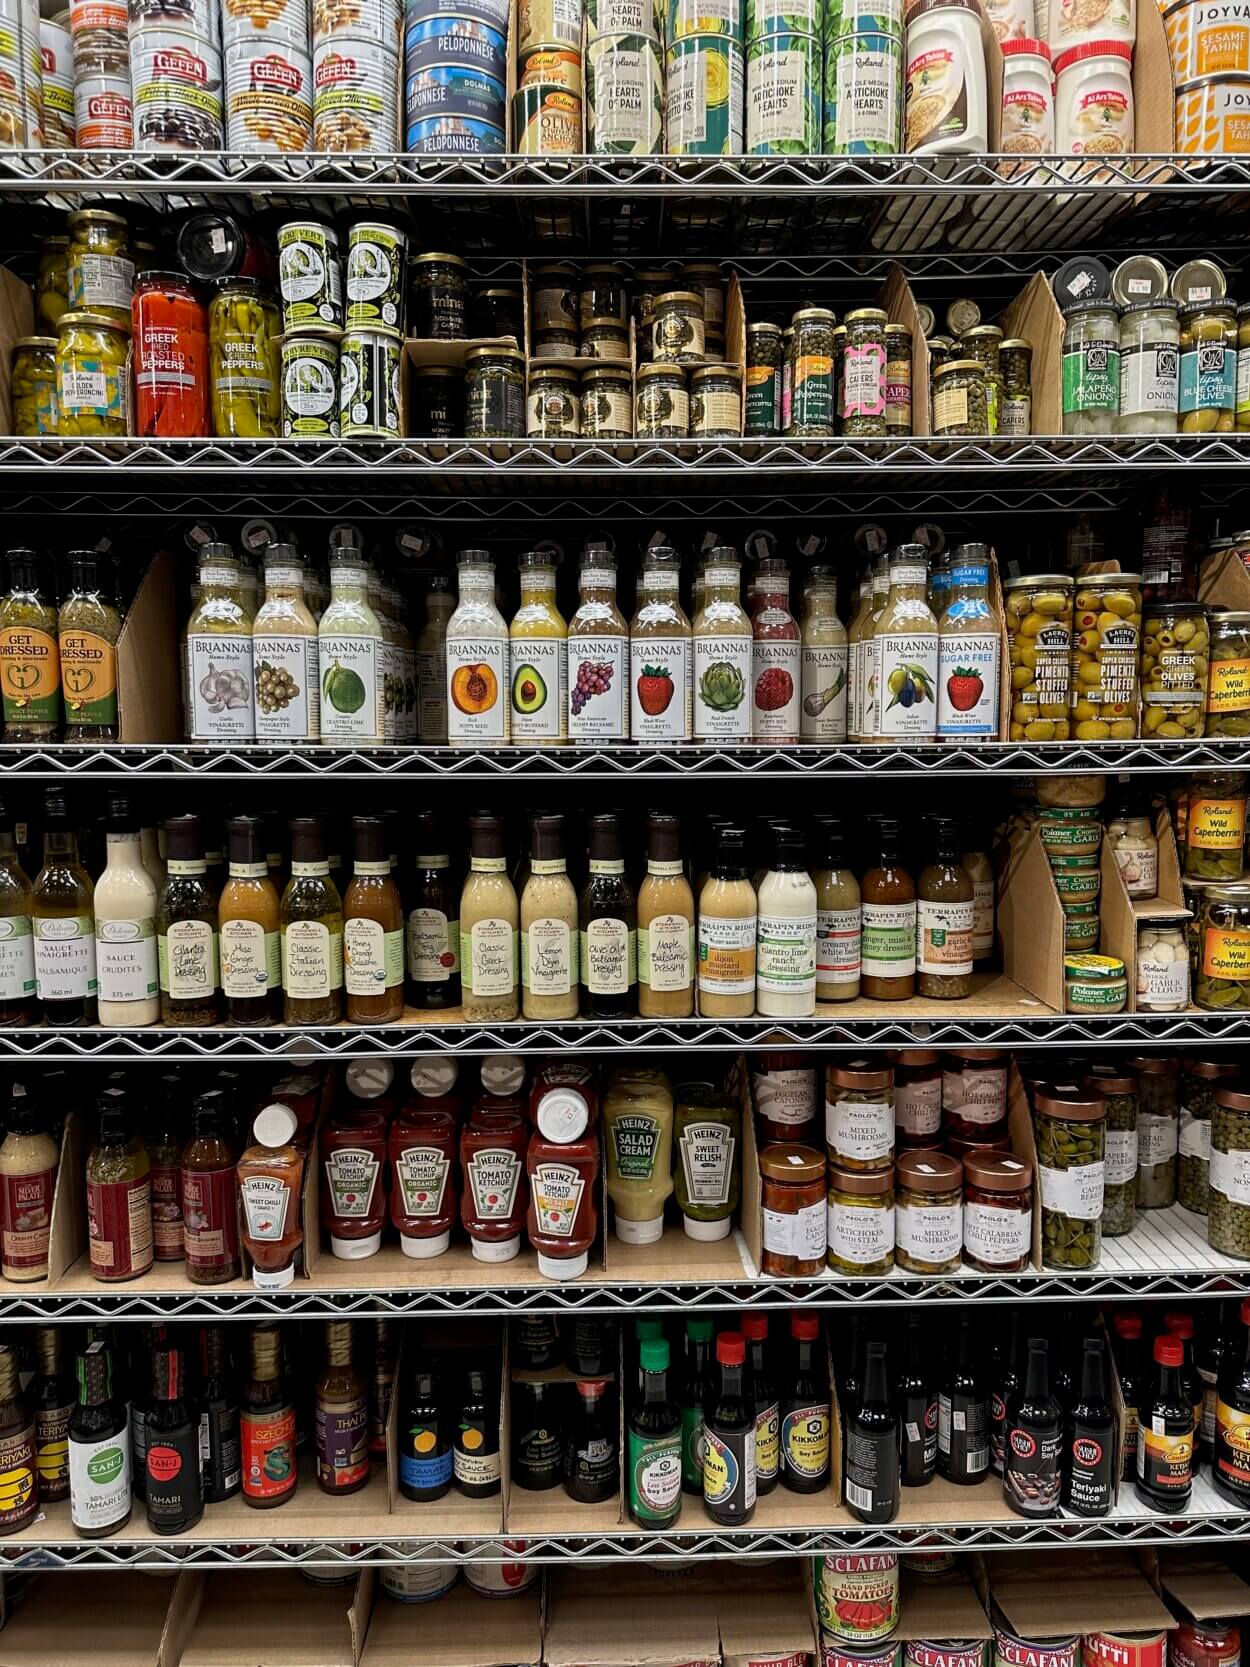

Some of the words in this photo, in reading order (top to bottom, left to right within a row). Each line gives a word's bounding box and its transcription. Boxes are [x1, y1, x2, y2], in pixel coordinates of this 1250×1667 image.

[621, 17, 642, 29] PALM
[1200, 33, 1246, 45] SESAME
[438, 37, 494, 61] PELOPONNESE
[1205, 42, 1243, 54] TAHINI
[156, 54, 203, 75] GEFEN
[855, 56, 884, 69] Roland
[464, 80, 491, 92] DOLMAS
[90, 101, 132, 116] GEFEN
[621, 99, 641, 110] PALM
[854, 100, 884, 110] HEARTS
[424, 137, 479, 152] PELOPONNESE
[145, 334, 178, 344] GREEK
[225, 344, 258, 353] GREEK
[141, 360, 184, 370] PEPPERS
[222, 360, 264, 370] PEPPERS
[807, 382, 827, 390] Green
[1205, 386, 1232, 394] CHEESE
[1077, 392, 1113, 401] ONIONS
[1197, 392, 1225, 400] OLIVES
[1002, 415, 1025, 425] CAPERS
[953, 568, 973, 577] SUGAR
[1042, 630, 1068, 638] LAUREL
[1109, 629, 1135, 638] LAUREL
[8, 635, 32, 645] GET
[65, 638, 86, 648] GET
[1113, 637, 1131, 645] HILL
[0, 646, 49, 656] DRESSED
[195, 641, 251, 654] BRIANNAS
[319, 641, 371, 653] BRIANNAS
[449, 645, 500, 656] BRIANNAS
[568, 642, 619, 654] BRIANNAS
[632, 645, 682, 656] BRIANNAS
[697, 642, 749, 654] BRIANNAS
[886, 641, 937, 652] BRIANNAS
[939, 641, 994, 652] BRIANNAS
[939, 655, 969, 663] SUGAR
[971, 653, 993, 662] FREE
[1161, 656, 1195, 665] GREEK
[1160, 672, 1195, 681] OLIVES
[1217, 666, 1248, 677] Roland
[1160, 681, 1194, 689] PITTED
[1225, 679, 1243, 689] Wild
[1039, 691, 1065, 704] OLIVES
[1104, 691, 1130, 703] OLIVES
[1203, 806, 1232, 816] Roland
[1210, 818, 1228, 828] Wild
[1042, 828, 1072, 838] Polaner
[1194, 827, 1240, 838] Caperberries
[657, 940, 679, 953] Maple
[823, 941, 847, 950] creamy
[1223, 936, 1250, 947] Roland
[291, 943, 322, 953] Classic
[479, 943, 506, 953] Classic
[537, 945, 562, 955] Lemon
[589, 943, 607, 953] Olive
[609, 943, 619, 953] Oil
[760, 947, 791, 957] cilantro
[792, 948, 808, 956] lime
[821, 948, 840, 956] white
[880, 943, 912, 952] dressing
[106, 954, 136, 962] SAUCE
[291, 953, 324, 965] Italian
[481, 954, 504, 965] Greek
[591, 955, 626, 965] Balsamic
[652, 952, 687, 963] Balsamic
[714, 954, 734, 963] dijon
[772, 956, 795, 964] ranch
[1228, 950, 1246, 960] Wild
[541, 956, 560, 967] Dijon
[709, 961, 740, 969] mustard
[478, 965, 509, 979] Dressing
[531, 966, 568, 980] Vinaigrette
[592, 963, 622, 978] Dressing
[654, 961, 685, 977] Dressing
[767, 964, 800, 975] dressing
[1143, 964, 1169, 973] Roland
[290, 965, 327, 983] Dressing
[1151, 979, 1182, 987] GARLIC
[1072, 986, 1105, 996] Polaner
[1150, 985, 1184, 993] CLOVES
[621, 1119, 651, 1130] HEINZ
[619, 1134, 653, 1146] SALAD
[693, 1130, 721, 1140] HEINZ
[838, 1131, 887, 1140] MUSHROOMS
[620, 1145, 651, 1155] CREAM
[696, 1145, 719, 1153] SWEET
[338, 1154, 365, 1165] HEINZ
[410, 1153, 435, 1163] HEINZ
[480, 1155, 508, 1165] HEINZ
[694, 1153, 722, 1162] RELISH
[477, 1170, 511, 1180] TOMATO
[543, 1172, 571, 1182] HEINZ
[251, 1182, 276, 1191] HEINZ
[479, 1178, 510, 1186] KETCHUP
[544, 1184, 571, 1193] TOMATO
[836, 1226, 884, 1237] ARTICHOKES
[924, 1229, 949, 1237] MIXED
[857, 1235, 878, 1243] STEM
[911, 1235, 958, 1243] MUSHROOMS
[987, 1236, 1019, 1244] PEPPERS
[92, 1458, 121, 1473] SAN-J
[151, 1459, 177, 1468] SAN-J
[650, 1467, 679, 1477] KIKKOMAN
[1071, 1481, 1106, 1493] Teriyaki
[149, 1495, 180, 1503] TAMARI
[1071, 1490, 1100, 1502] Sauce
[85, 1498, 116, 1509] TAMARI
[825, 1556, 898, 1572] SCLAFANI
[865, 1581, 889, 1589] PICKED
[833, 1586, 894, 1598] TOMATOES
